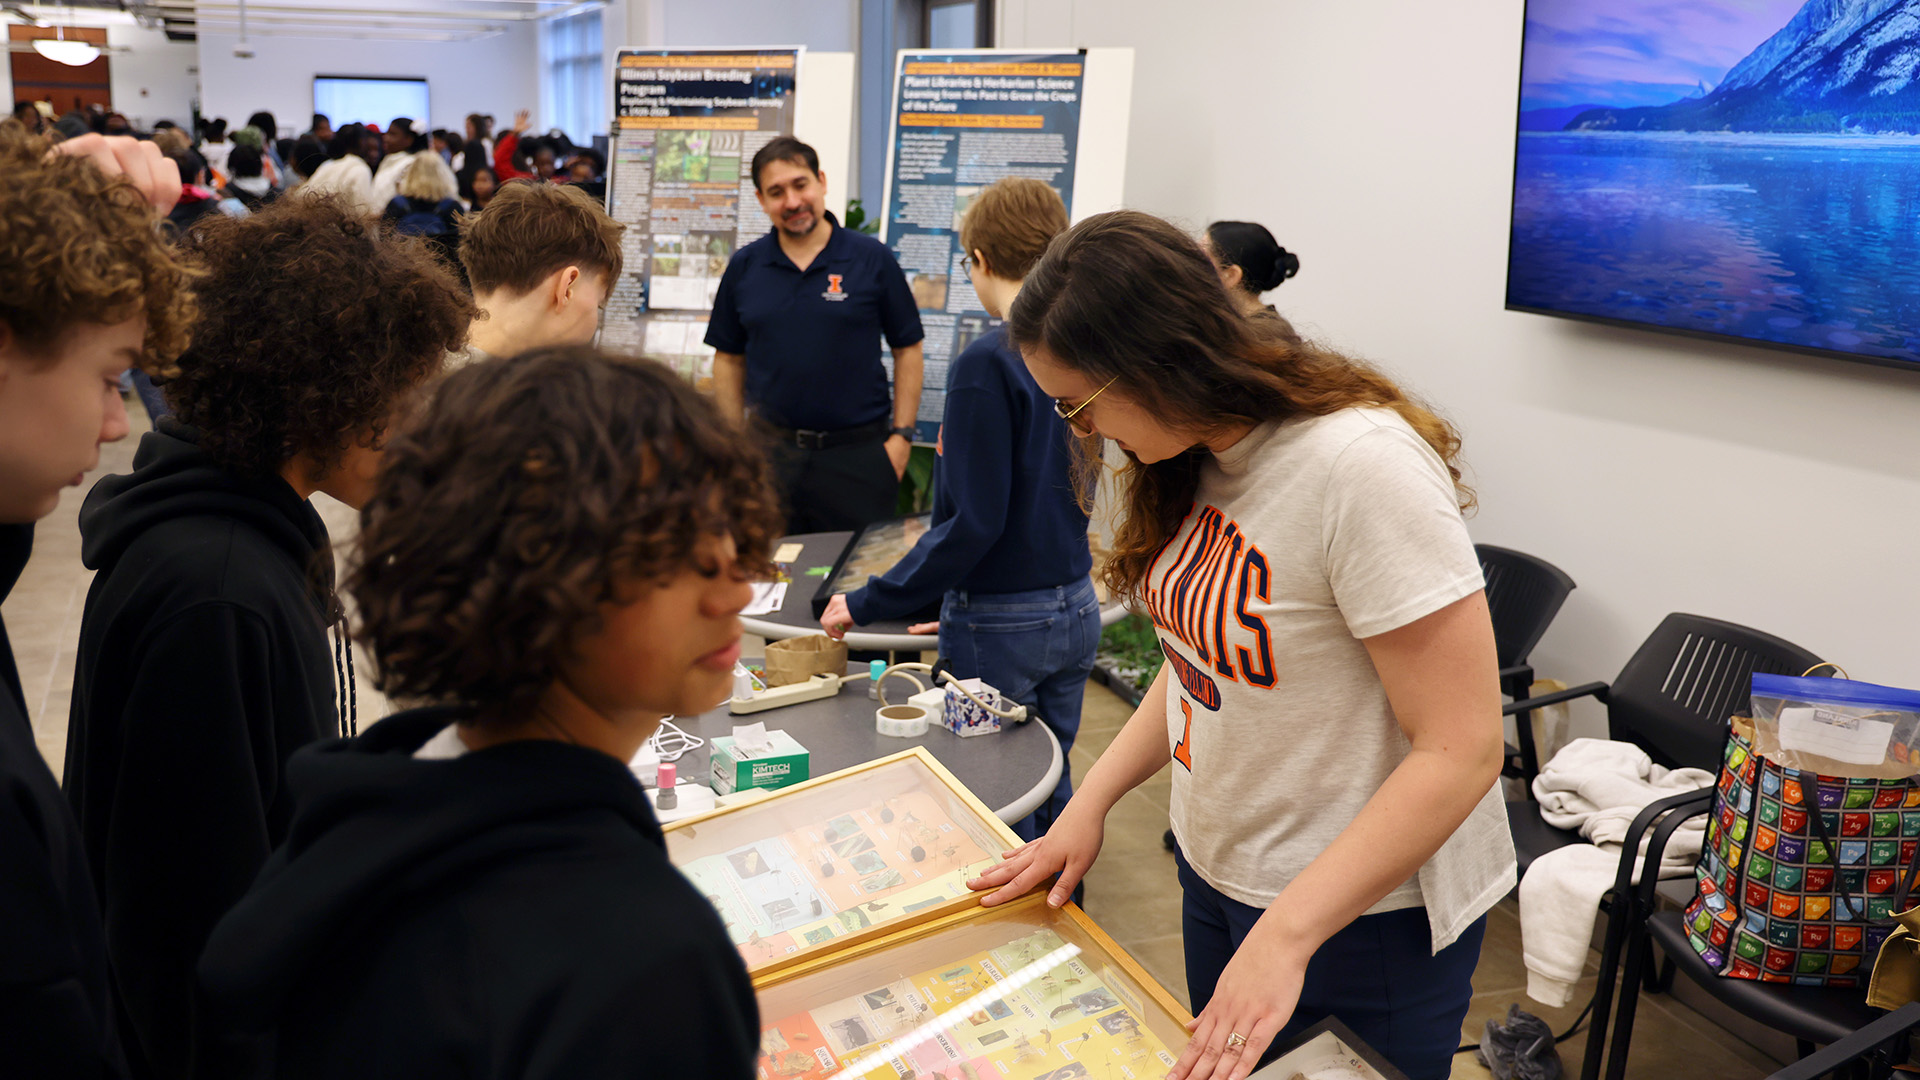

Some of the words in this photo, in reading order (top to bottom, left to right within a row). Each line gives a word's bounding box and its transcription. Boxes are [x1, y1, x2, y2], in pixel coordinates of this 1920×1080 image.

[620, 69, 656, 81] Illinois
[657, 70, 701, 82] Soybean
[704, 70, 752, 84] Breeding
[904, 76, 930, 87] Plant
[931, 77, 972, 88] Libraries
[1037, 79, 1075, 90] Science
[620, 83, 666, 96] Program
[903, 89, 940, 100] Learning
[942, 90, 962, 99] from
[963, 90, 977, 100] the
[979, 91, 998, 100] Past
[1000, 92, 1008, 100] to
[1010, 91, 1033, 101] Grow
[1035, 91, 1049, 101] the
[1051, 92, 1077, 102] Crops
[902, 102, 911, 111] of
[912, 102, 927, 111] the
[929, 102, 957, 112] Future
[752, 763, 790, 774] KIMTECH
[1745, 944, 1756, 952] Rn
[1068, 962, 1086, 976] BEANS
[1020, 1004, 1036, 1018] ONION
[936, 1032, 957, 1058] ORSERADISH
[817, 1049, 833, 1067] SQUASH
[1160, 1052, 1173, 1065] CORN
